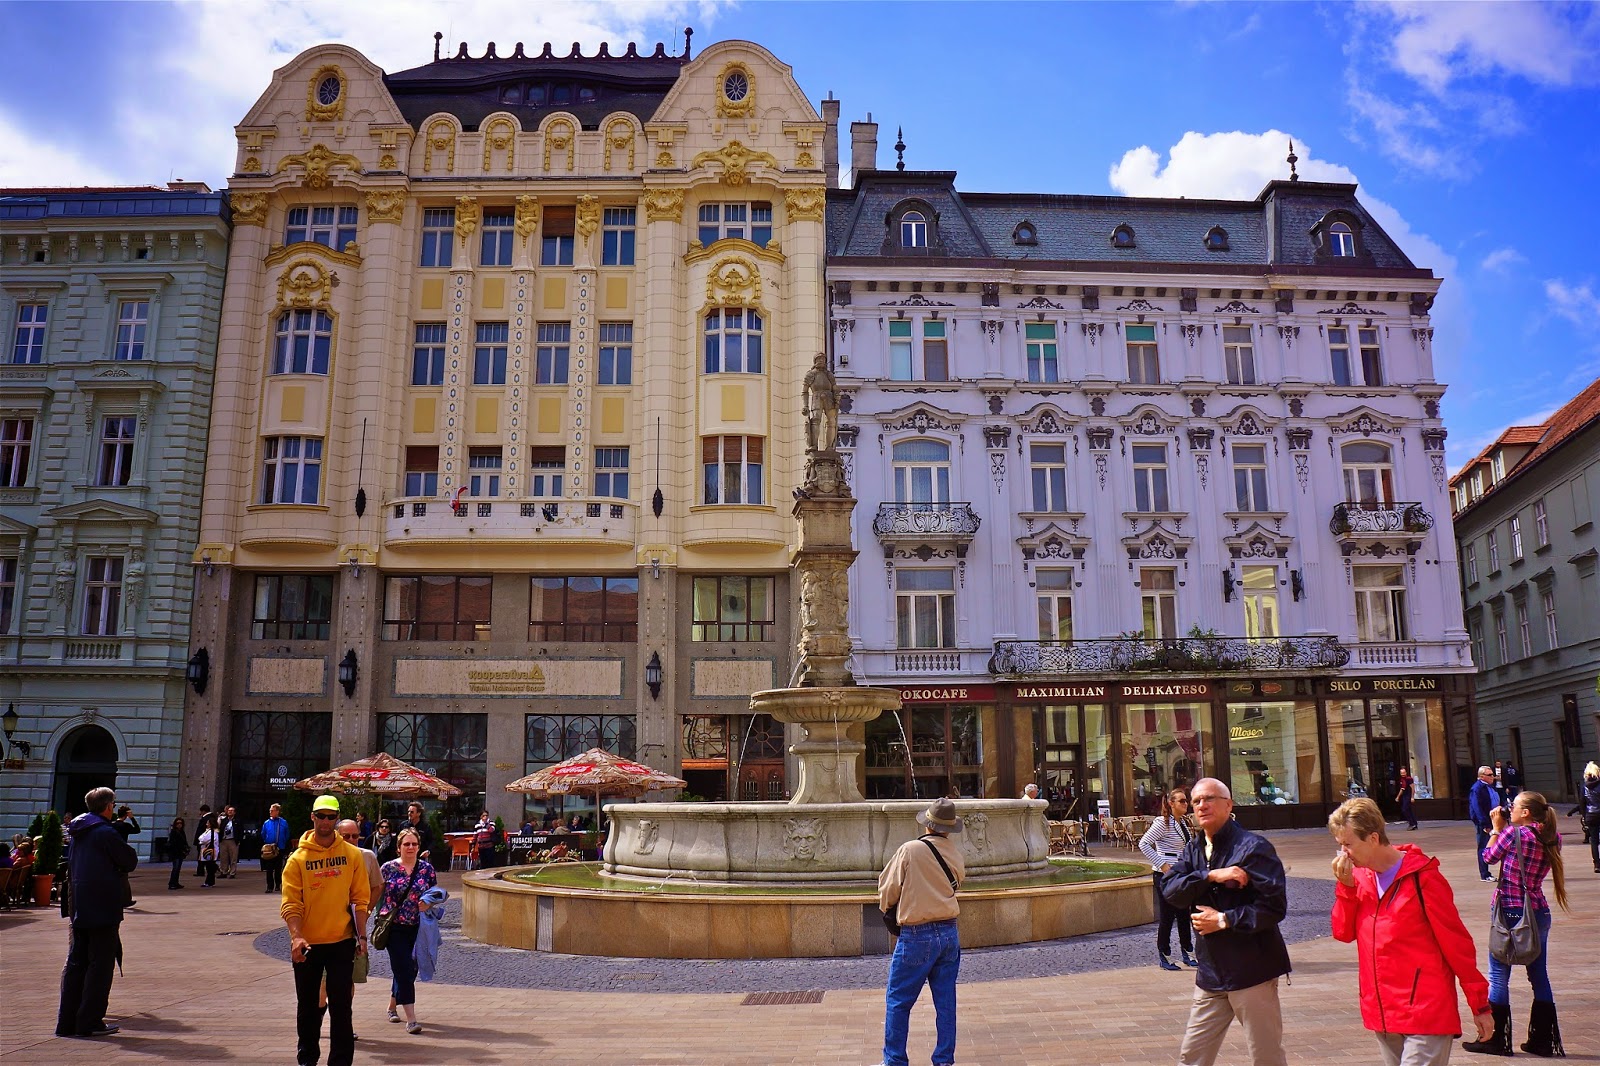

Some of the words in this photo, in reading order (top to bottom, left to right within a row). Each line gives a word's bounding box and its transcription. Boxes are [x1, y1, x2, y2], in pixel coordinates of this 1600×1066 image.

[468, 670, 528, 681] Kooperativa
[1122, 684, 1207, 696] DELIKATESO
[1330, 681, 1361, 692] SKLO
[1373, 677, 1436, 690] PORCELÁN
[899, 688, 968, 700] OKOCAFE
[1017, 686, 1105, 698] MAXIMILIAN
[305, 858, 324, 871] CITY
[325, 856, 348, 868] TOUR
